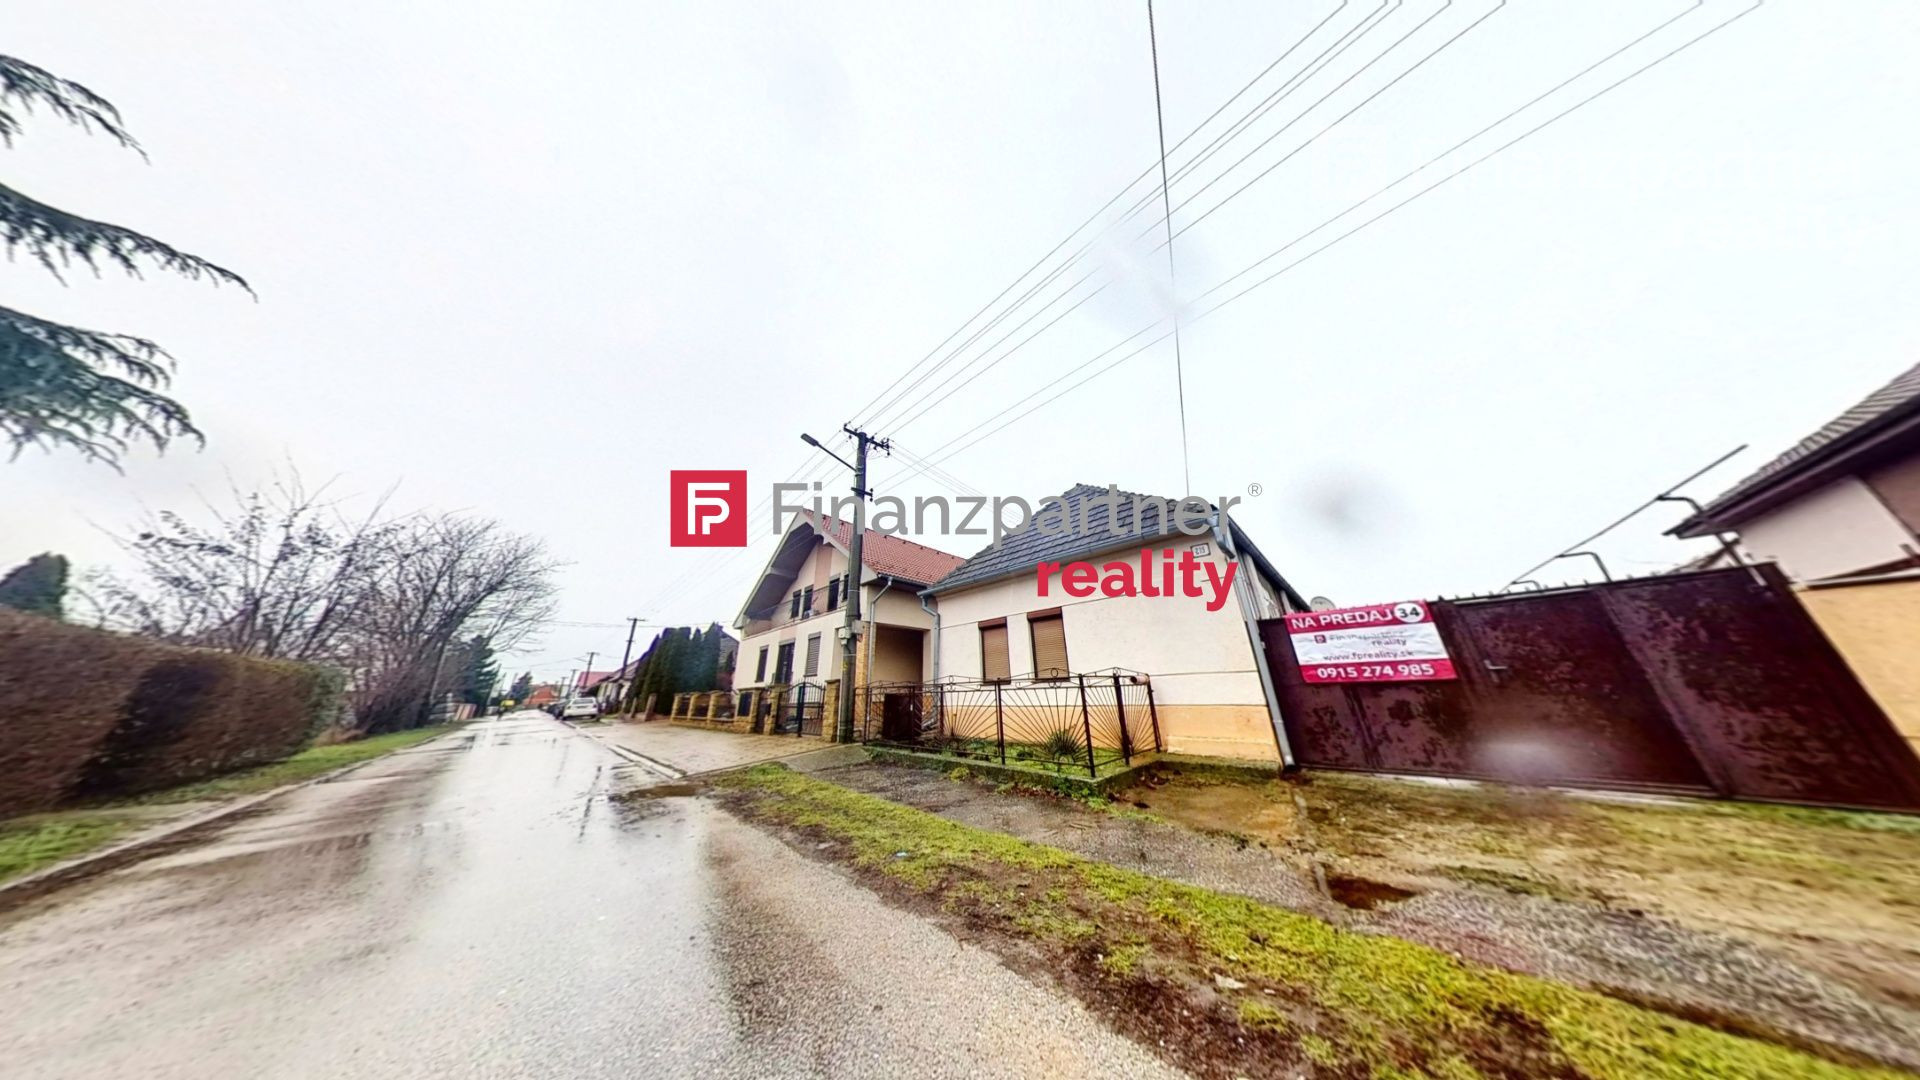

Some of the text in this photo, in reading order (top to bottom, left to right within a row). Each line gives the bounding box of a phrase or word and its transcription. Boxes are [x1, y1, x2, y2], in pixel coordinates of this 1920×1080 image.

[1291, 606, 1421, 630] NA PREDAJ 34
[1371, 637, 1407, 647] reality
[1323, 650, 1414, 661] www.fpreality.sk
[1317, 663, 1434, 679] 0915 274 985
